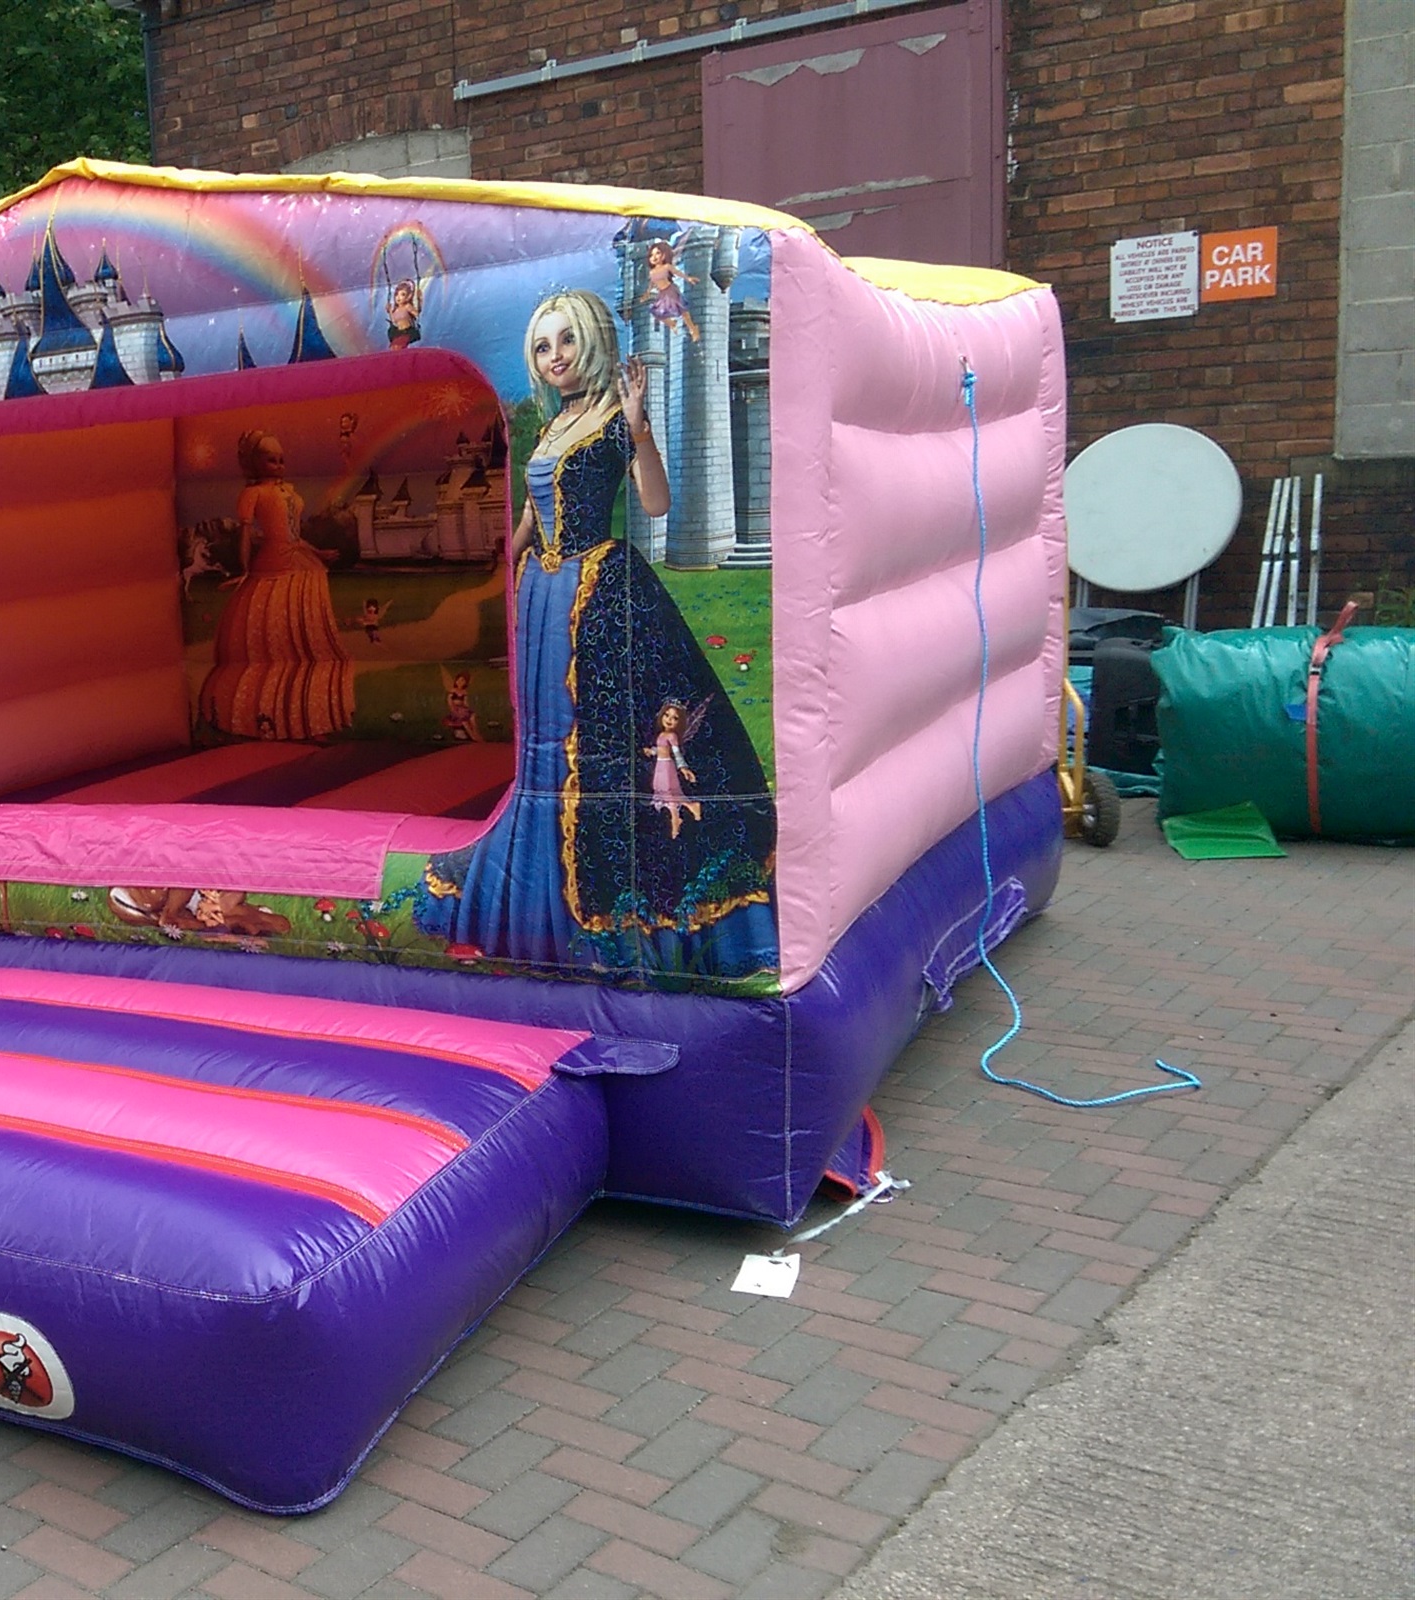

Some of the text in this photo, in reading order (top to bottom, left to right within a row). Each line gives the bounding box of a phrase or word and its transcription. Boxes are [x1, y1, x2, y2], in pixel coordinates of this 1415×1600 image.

[1137, 237, 1173, 250] NOTICE
[1128, 251, 1155, 260] VEHICLES
[1212, 242, 1263, 266] CAR
[1205, 263, 1272, 290] PARK
